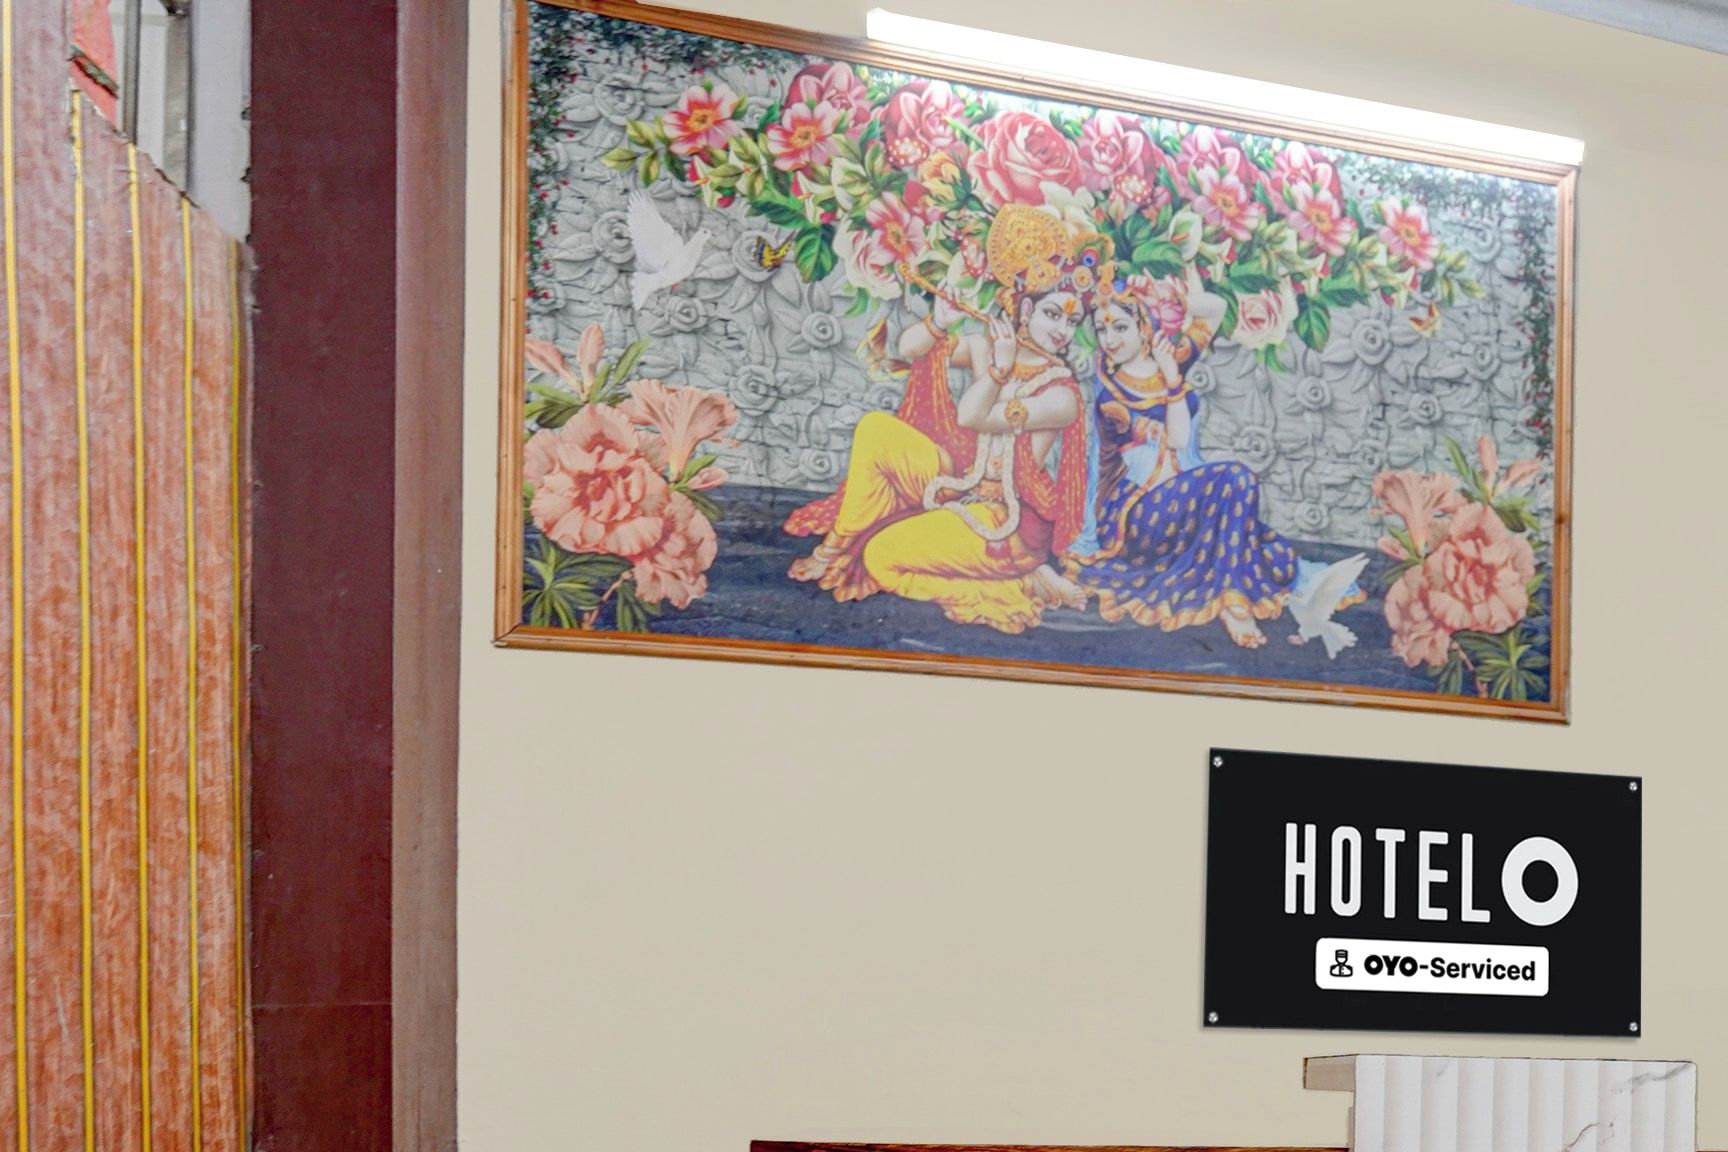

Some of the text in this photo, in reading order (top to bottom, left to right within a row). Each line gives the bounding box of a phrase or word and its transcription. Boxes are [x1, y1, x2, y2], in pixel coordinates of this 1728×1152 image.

[1284, 822, 1579, 927] HOTEL O
[1364, 953, 1536, 982] OYO-Serviced
